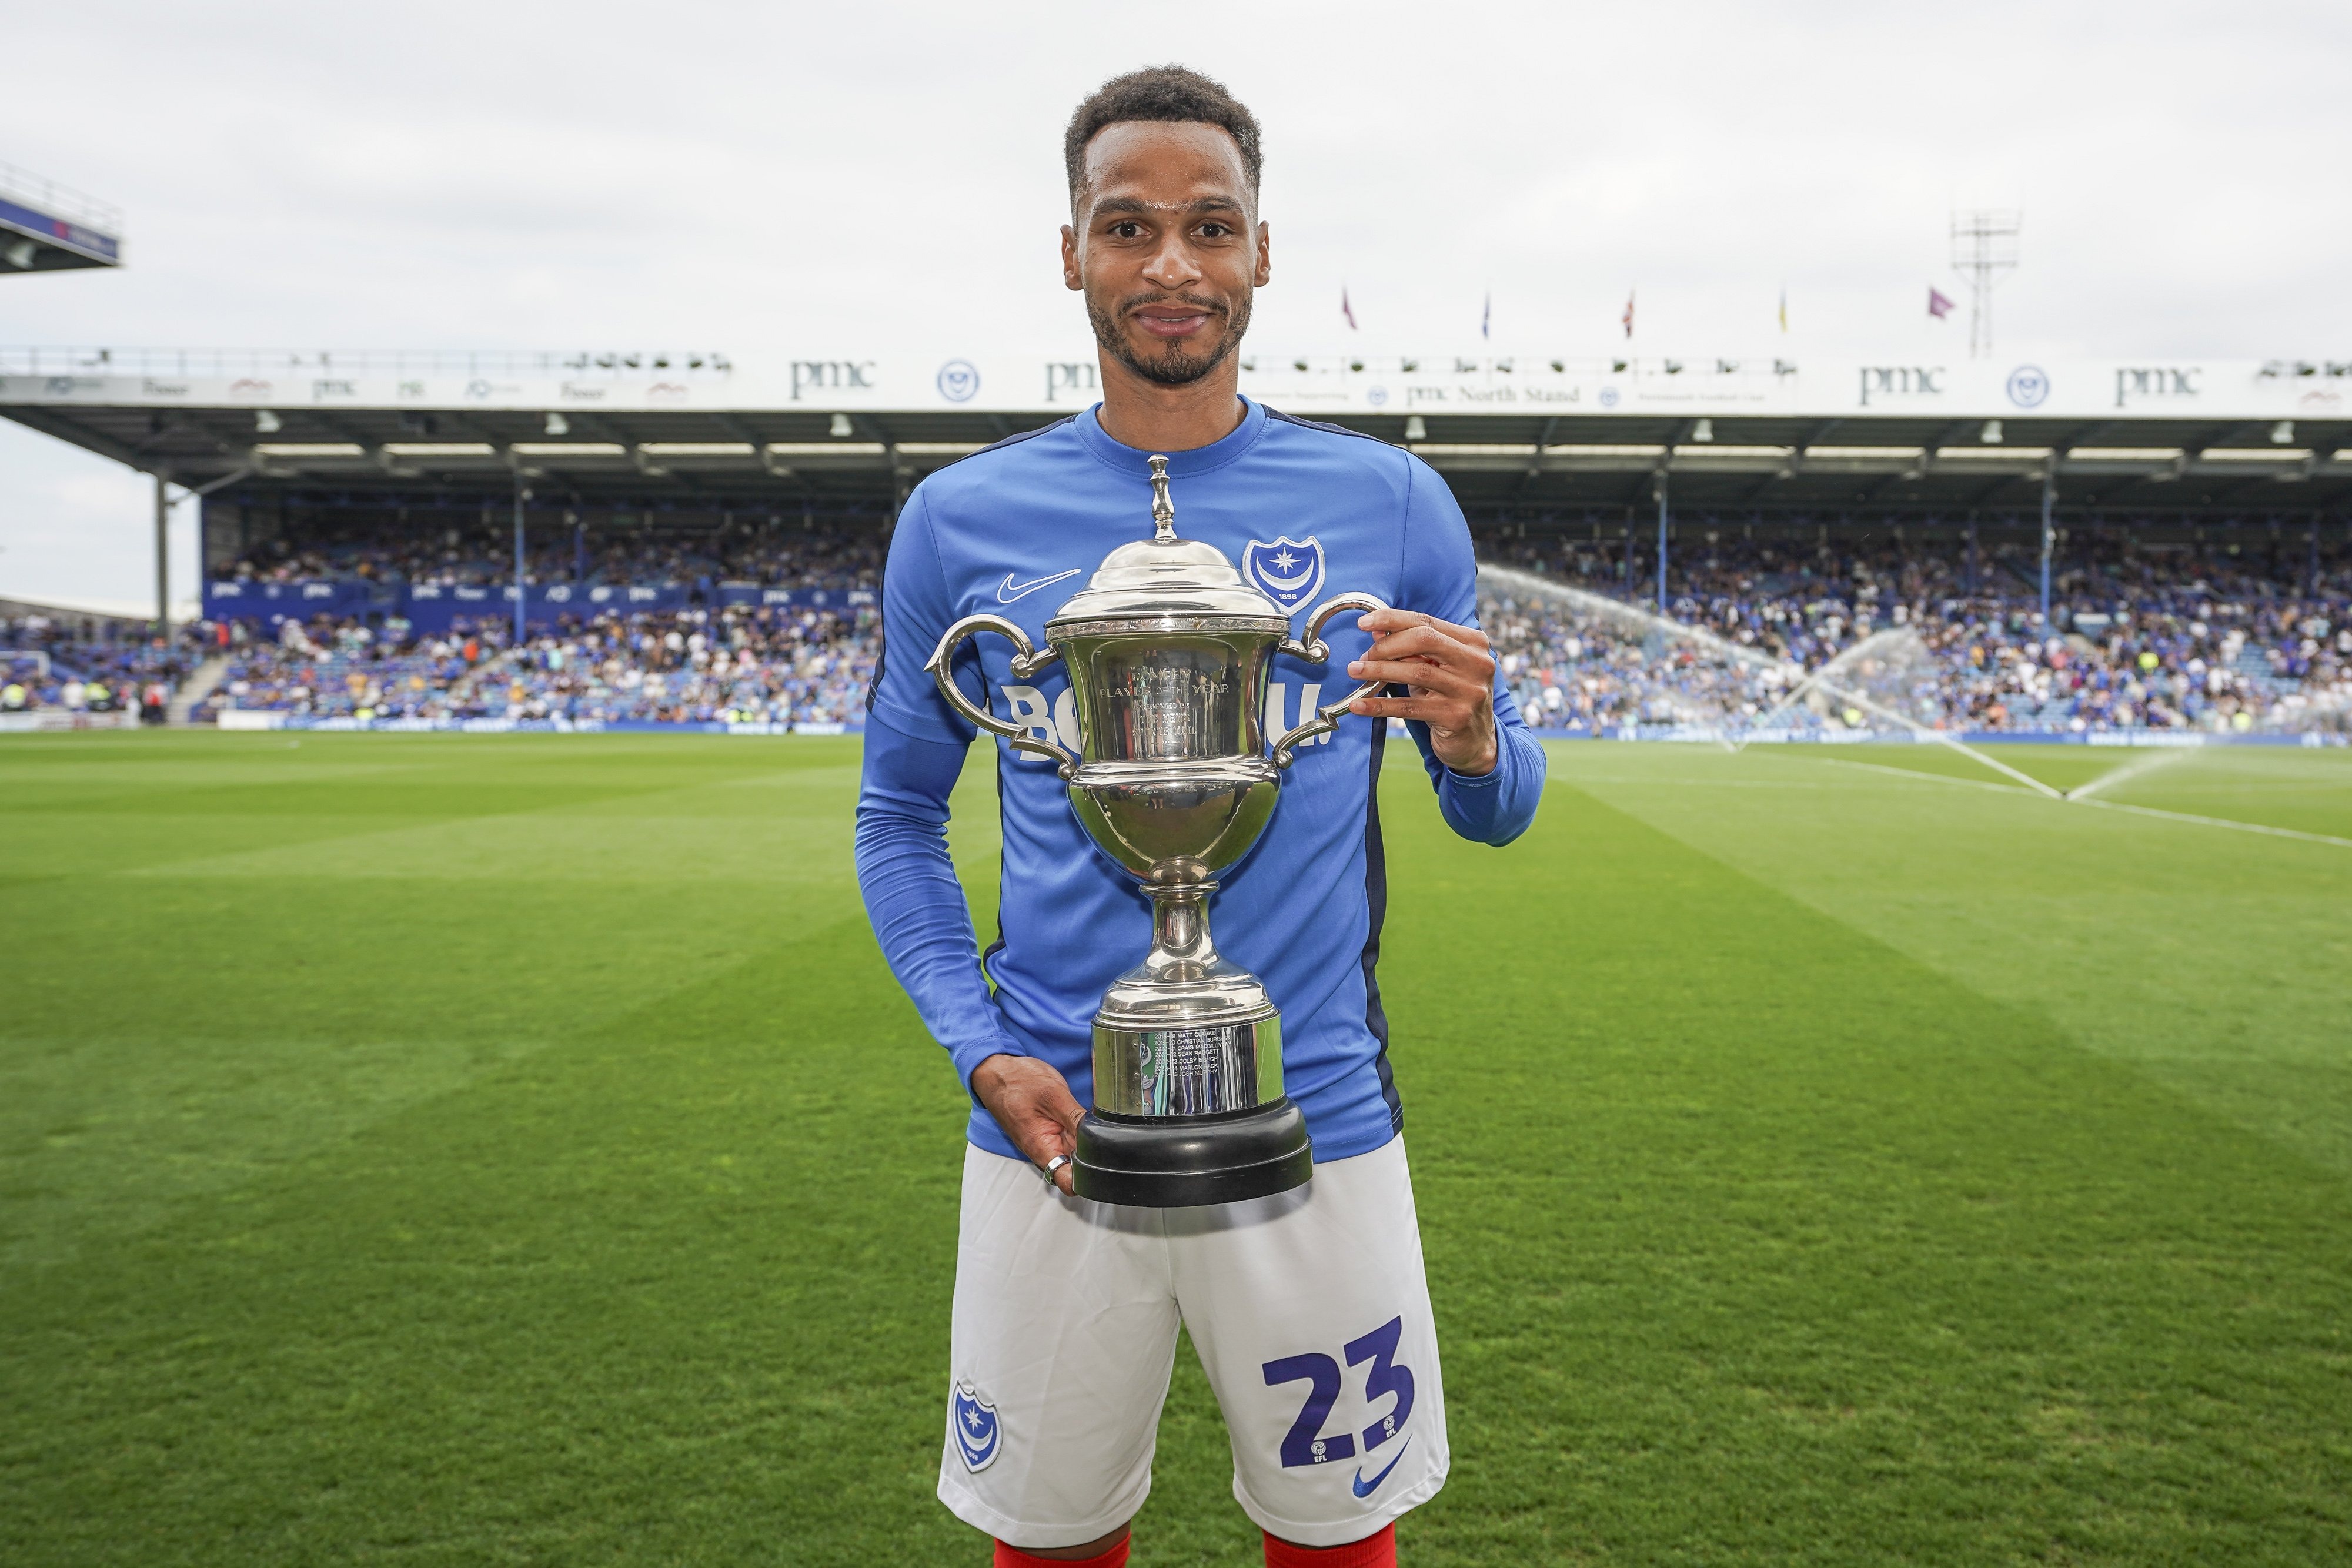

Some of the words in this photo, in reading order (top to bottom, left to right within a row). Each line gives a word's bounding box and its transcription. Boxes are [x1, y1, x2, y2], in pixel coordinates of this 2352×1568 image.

[791, 361, 876, 401] pmc
[1045, 363, 1095, 401] pm
[1458, 385, 1517, 402] North
[1524, 385, 1580, 402] Stand
[1860, 366, 1946, 406] pmc
[2116, 367, 2202, 407] pmc
[1099, 686, 1151, 698] PLAYER
[1192, 684, 1229, 694] YEAR
[1262, 1315, 1414, 1468] 23
[1386, 1428, 1396, 1439] EFL
[1314, 1455, 1328, 1463] EFL
